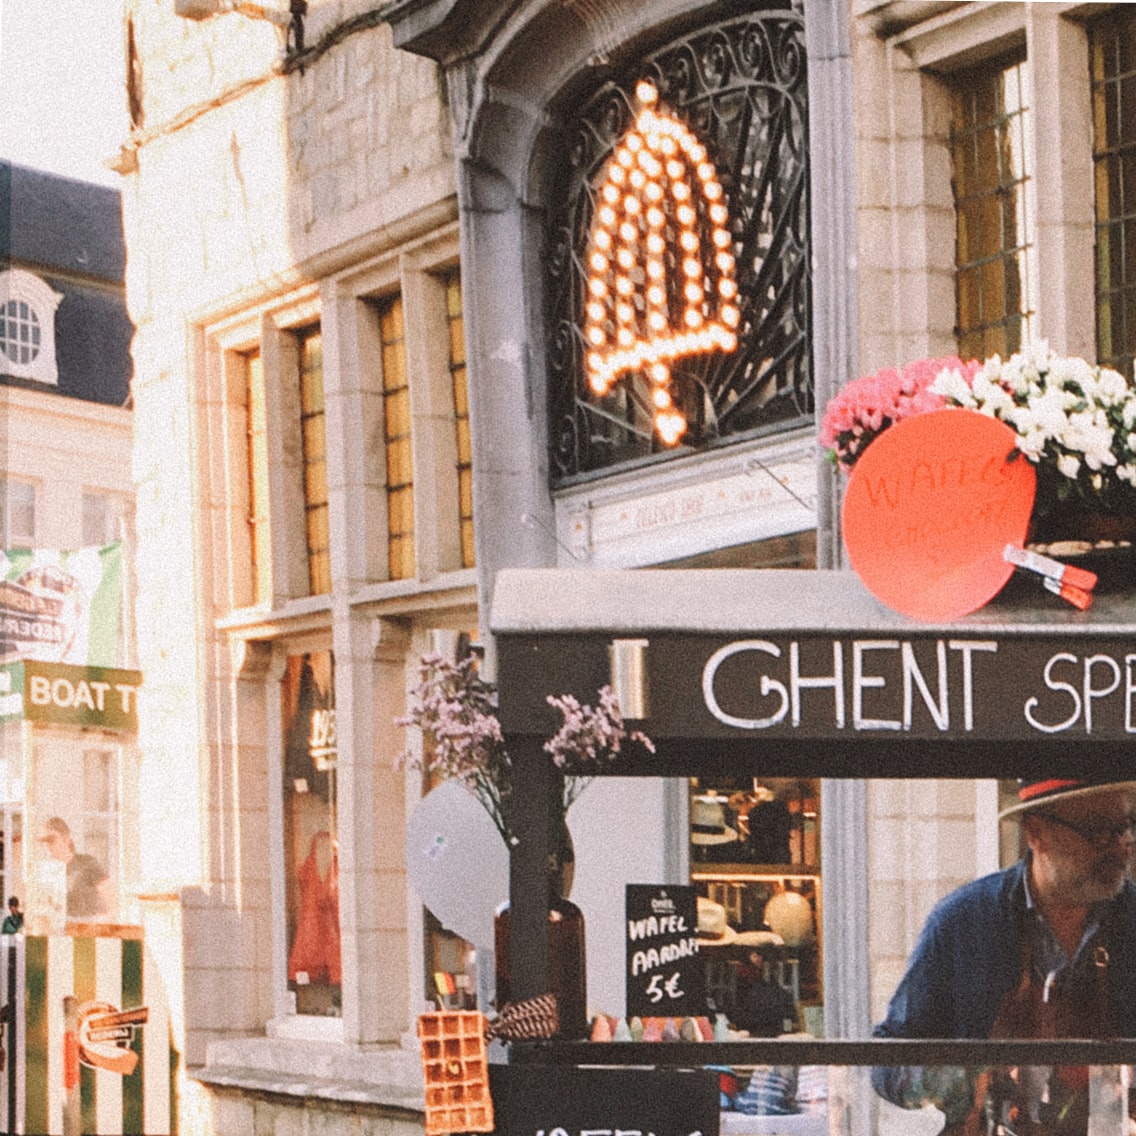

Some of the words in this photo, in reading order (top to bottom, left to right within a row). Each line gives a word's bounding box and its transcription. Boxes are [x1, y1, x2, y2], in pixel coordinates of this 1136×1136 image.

[30, 675, 110, 711] BOAT
[702, 639, 997, 732] GHENT
[628, 915, 688, 940] WAFEL
[645, 972, 685, 1003] 5€
